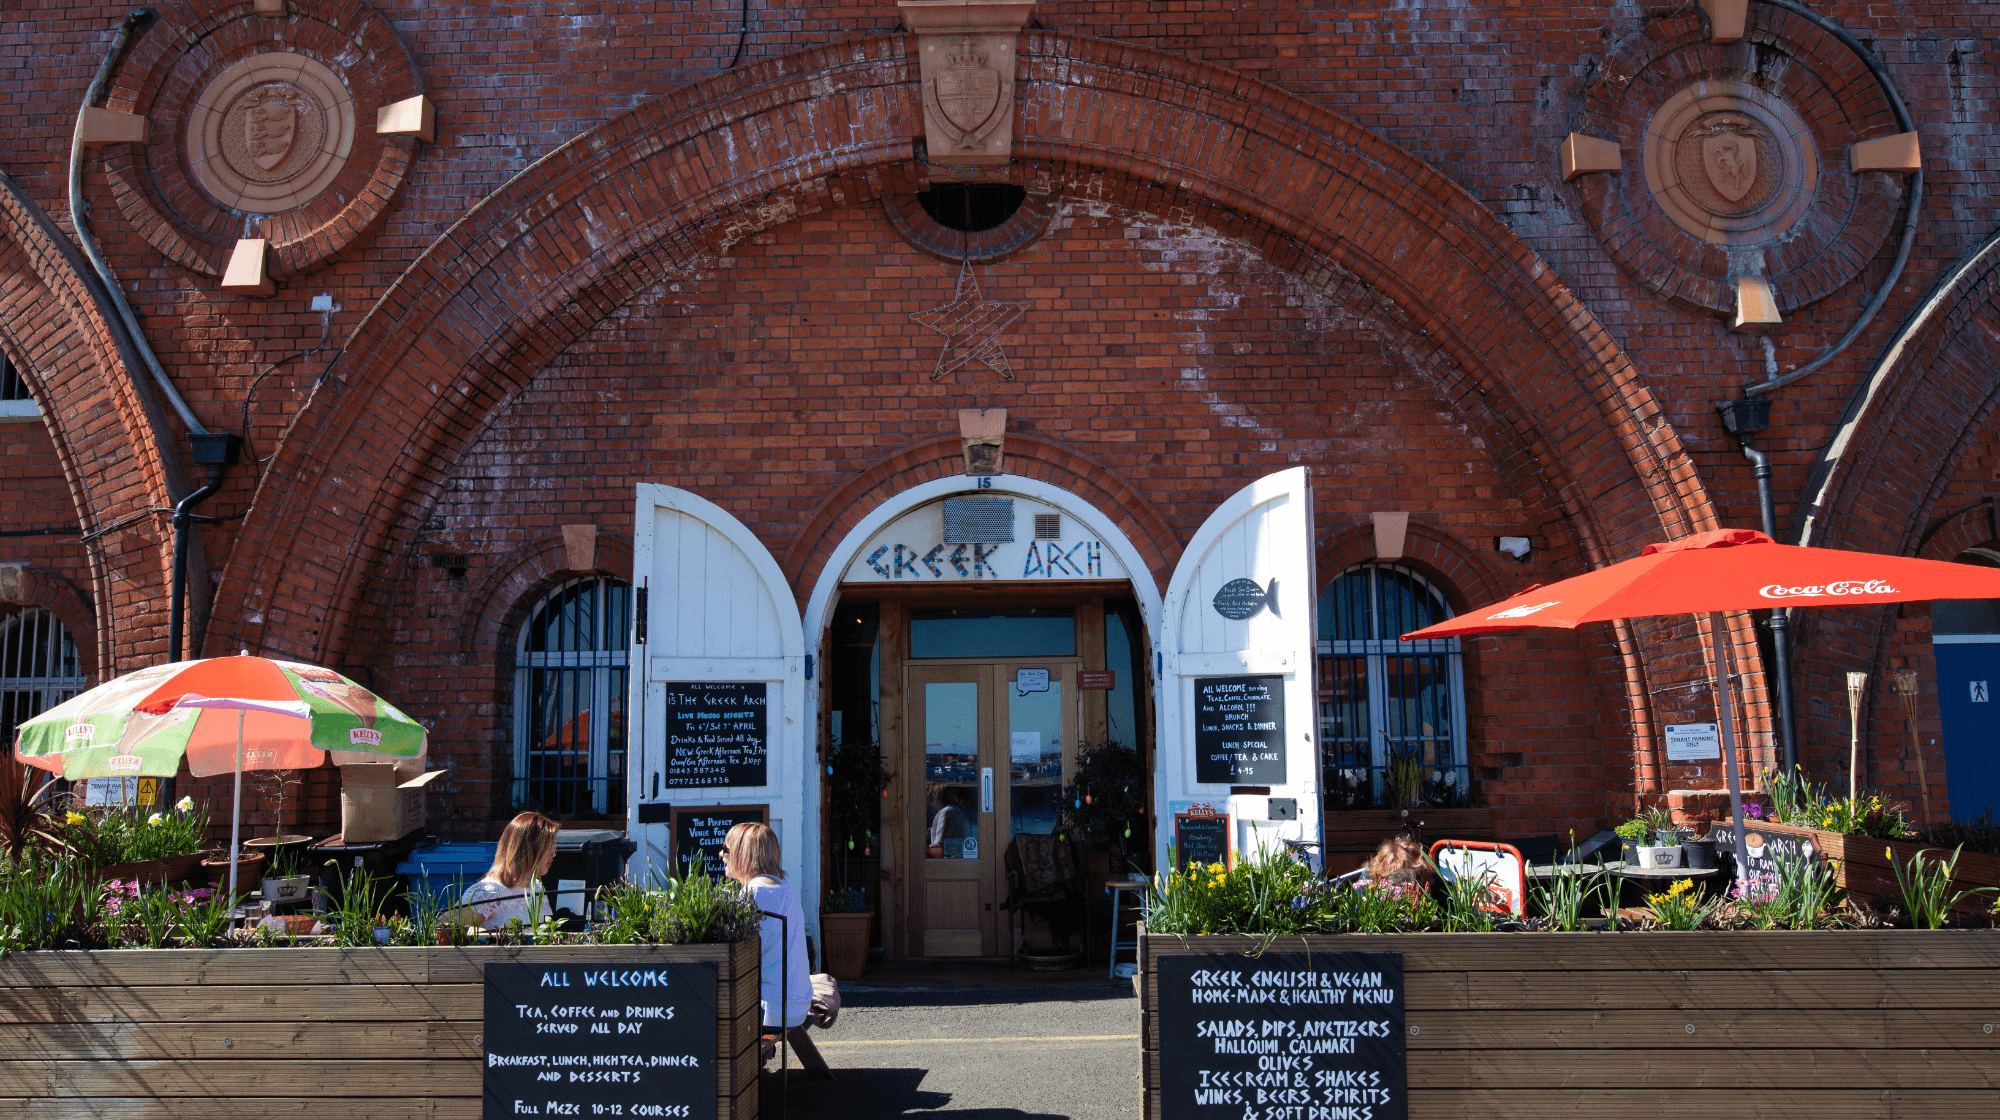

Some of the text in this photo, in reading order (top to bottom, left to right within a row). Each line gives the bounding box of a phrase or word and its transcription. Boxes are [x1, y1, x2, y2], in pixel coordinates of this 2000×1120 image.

[978, 477, 991, 488] 15
[866, 541, 1102, 579] GREEK ARCH
[1216, 684, 1246, 692] WELCOME
[678, 693, 697, 705] THE
[704, 692, 737, 705] GREEK
[743, 694, 765, 705] ARCH
[697, 711, 720, 719] MUSIC
[724, 711, 754, 719] NIGHTS
[733, 722, 756, 730] APRIL
[1222, 723, 1244, 731] SNACKS
[1247, 722, 1253, 730] &
[1254, 721, 1277, 731] DINNER
[353, 730, 380, 740] KELLY'S
[1222, 741, 1268, 749] LUNCH SPECIAL
[1252, 753, 1258, 761] &
[1260, 753, 1279, 761] CAKE
[692, 817, 732, 827] THE PERFECT
[689, 827, 726, 837] VENUE FOR
[1716, 829, 1736, 844] GRE
[699, 838, 725, 846] CELEBR
[1747, 855, 1755, 867] TO
[706, 864, 726, 872] Wedd
[541, 970, 668, 987] ALL WELCOME
[1251, 971, 1316, 987] ENGLISH
[1320, 972, 1332, 988] &
[1333, 971, 1382, 987] VEGAN
[1192, 989, 1394, 1005] HOME-MADE & HEALTHY MENU
[516, 1005, 674, 1020] TEA, COFFEE AND DRINKS
[536, 1022, 643, 1034] SERVED ALL DAY
[1197, 1019, 1390, 1039] SALADS, DIPS, APPETIZERS
[1289, 1038, 1355, 1054] CALAMARI
[488, 1053, 550, 1068] BREAKFAST,
[552, 1055, 591, 1067] LUNCH,
[651, 1055, 699, 1067] DINNER
[1258, 1055, 1313, 1071] OLIVES
[537, 1071, 641, 1083] AND DESSERTS
[1294, 1072, 1310, 1088] &
[1315, 1070, 1380, 1087] SHAKES
[1194, 1089, 1250, 1107] WINES,
[1323, 1088, 1391, 1105] SPIRITS
[514, 1100, 689, 1118] FULL MEZE 10-12 COURSES
[1243, 1106, 1374, 1120] & SOFT DRINKS
